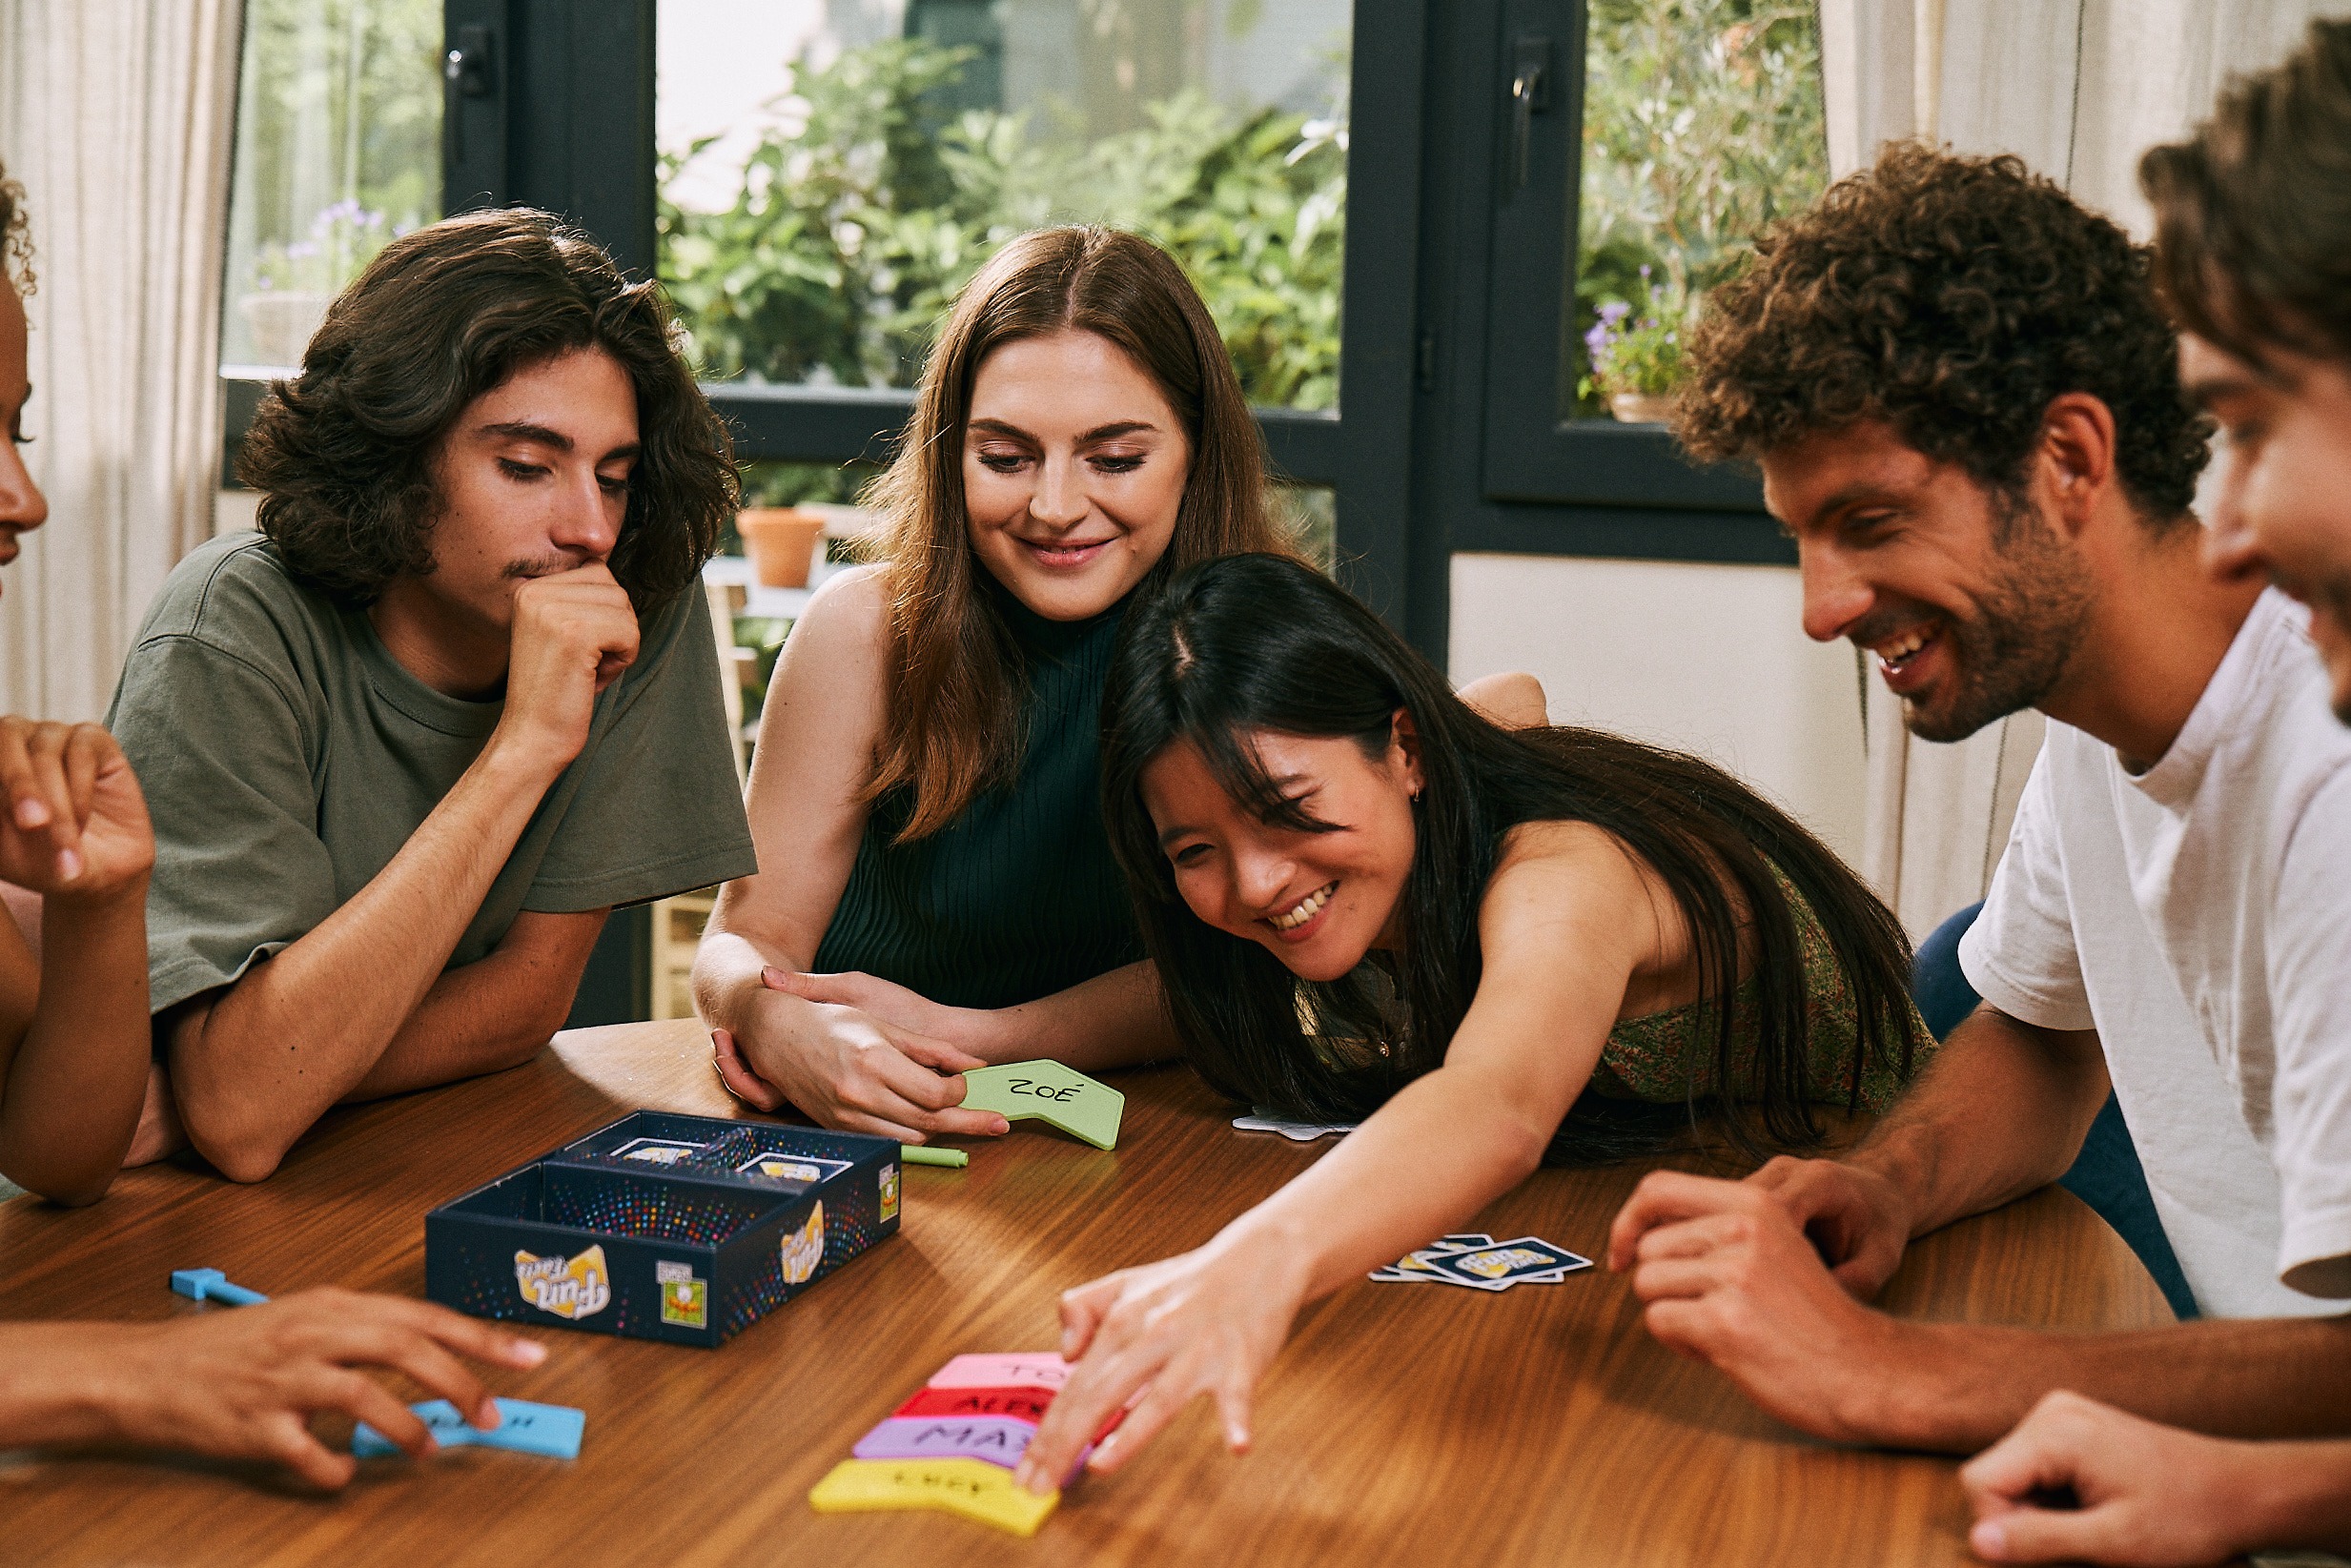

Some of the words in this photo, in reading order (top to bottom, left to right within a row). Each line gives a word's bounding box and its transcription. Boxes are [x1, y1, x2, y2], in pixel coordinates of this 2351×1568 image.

[1008, 1079, 1085, 1102] ZOÉ
[532, 1270, 610, 1320] Fun
[1001, 1364, 1065, 1382] TO
